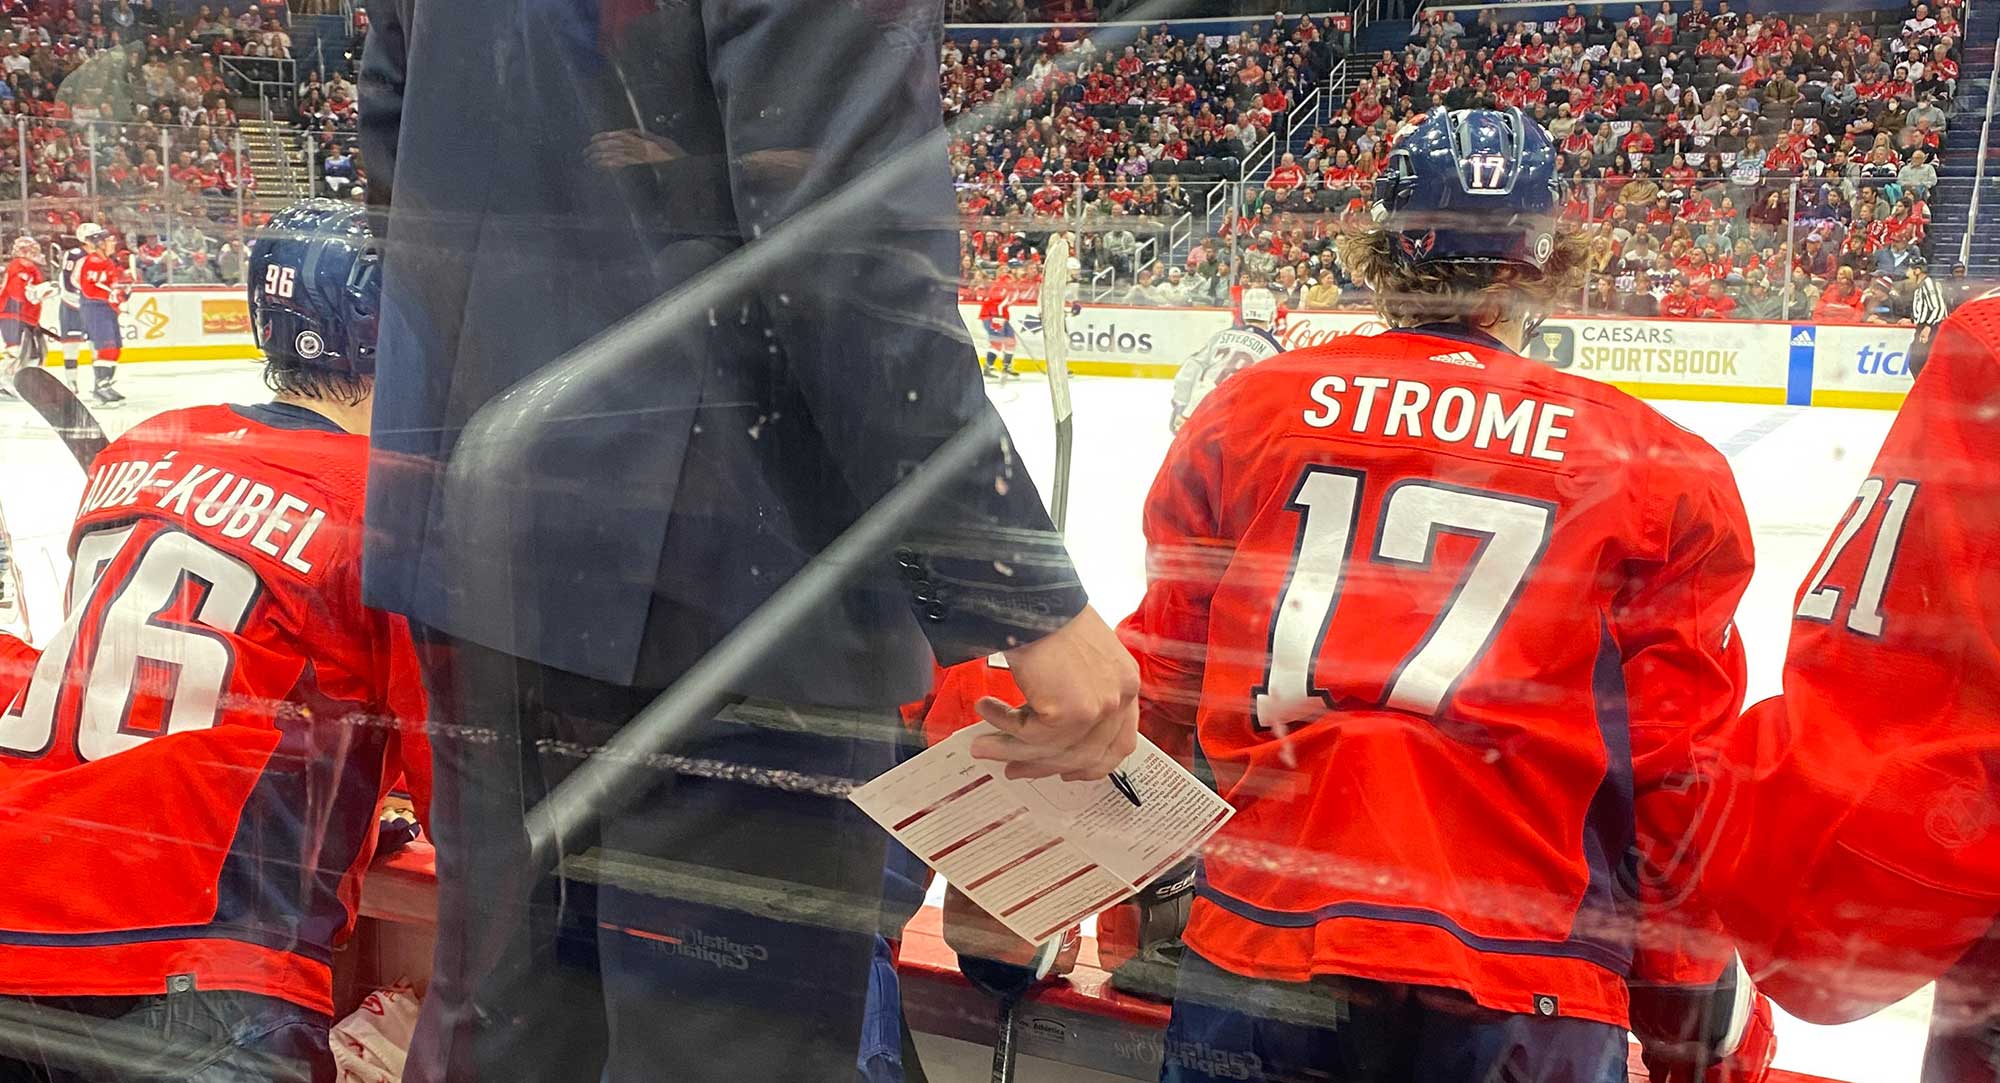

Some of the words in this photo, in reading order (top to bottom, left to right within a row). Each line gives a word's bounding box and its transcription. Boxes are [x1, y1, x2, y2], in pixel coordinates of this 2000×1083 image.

[1471, 154, 1505, 189] 17
[264, 263, 297, 299] 96
[1069, 323, 1153, 354] eidos
[1582, 326, 1673, 344] CAESARS
[1580, 346, 1739, 376] SPORTSBOOK
[1302, 375, 1576, 462] STROME
[1795, 476, 1920, 640] 21
[1252, 465, 1558, 731] 17
